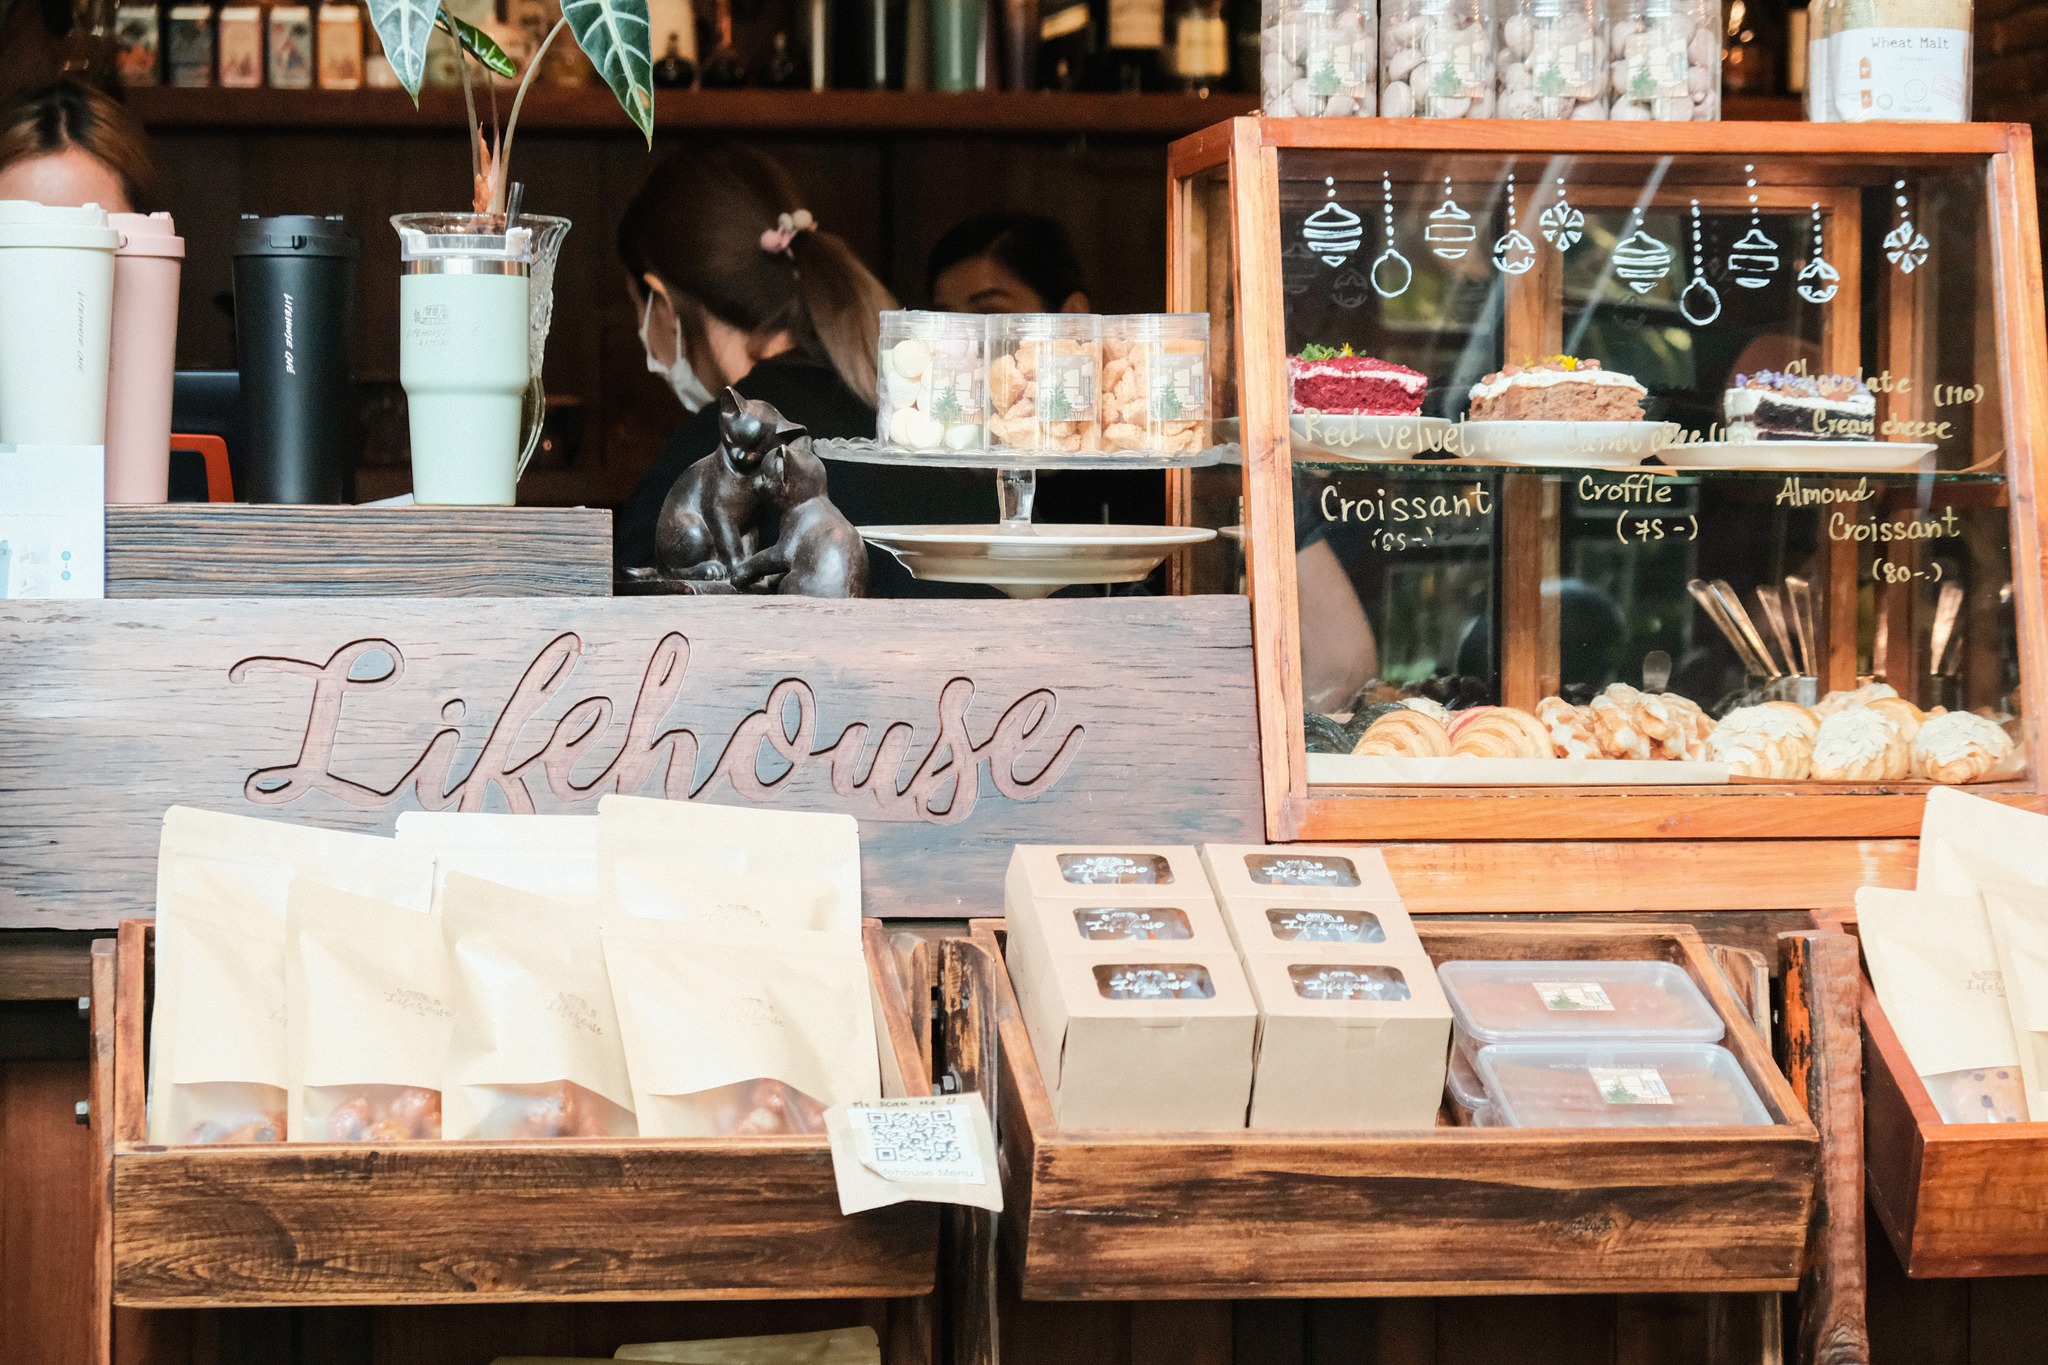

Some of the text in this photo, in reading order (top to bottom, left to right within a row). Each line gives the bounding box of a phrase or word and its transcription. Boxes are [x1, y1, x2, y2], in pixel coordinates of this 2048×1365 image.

[1871, 36, 1950, 50] Wheat Malt
[283, 292, 294, 350] LIFEHOUSE
[1304, 407, 1364, 447] Red
[1880, 412, 1954, 440] cheese
[1320, 481, 1493, 523] Croissant
[1578, 473, 1672, 504] Croffle
[1775, 476, 1876, 506] Almond
[1828, 505, 1961, 542] Croissant
[228, 630, 1086, 825] Lifehouse
[938, 1168, 975, 1177] Menu
